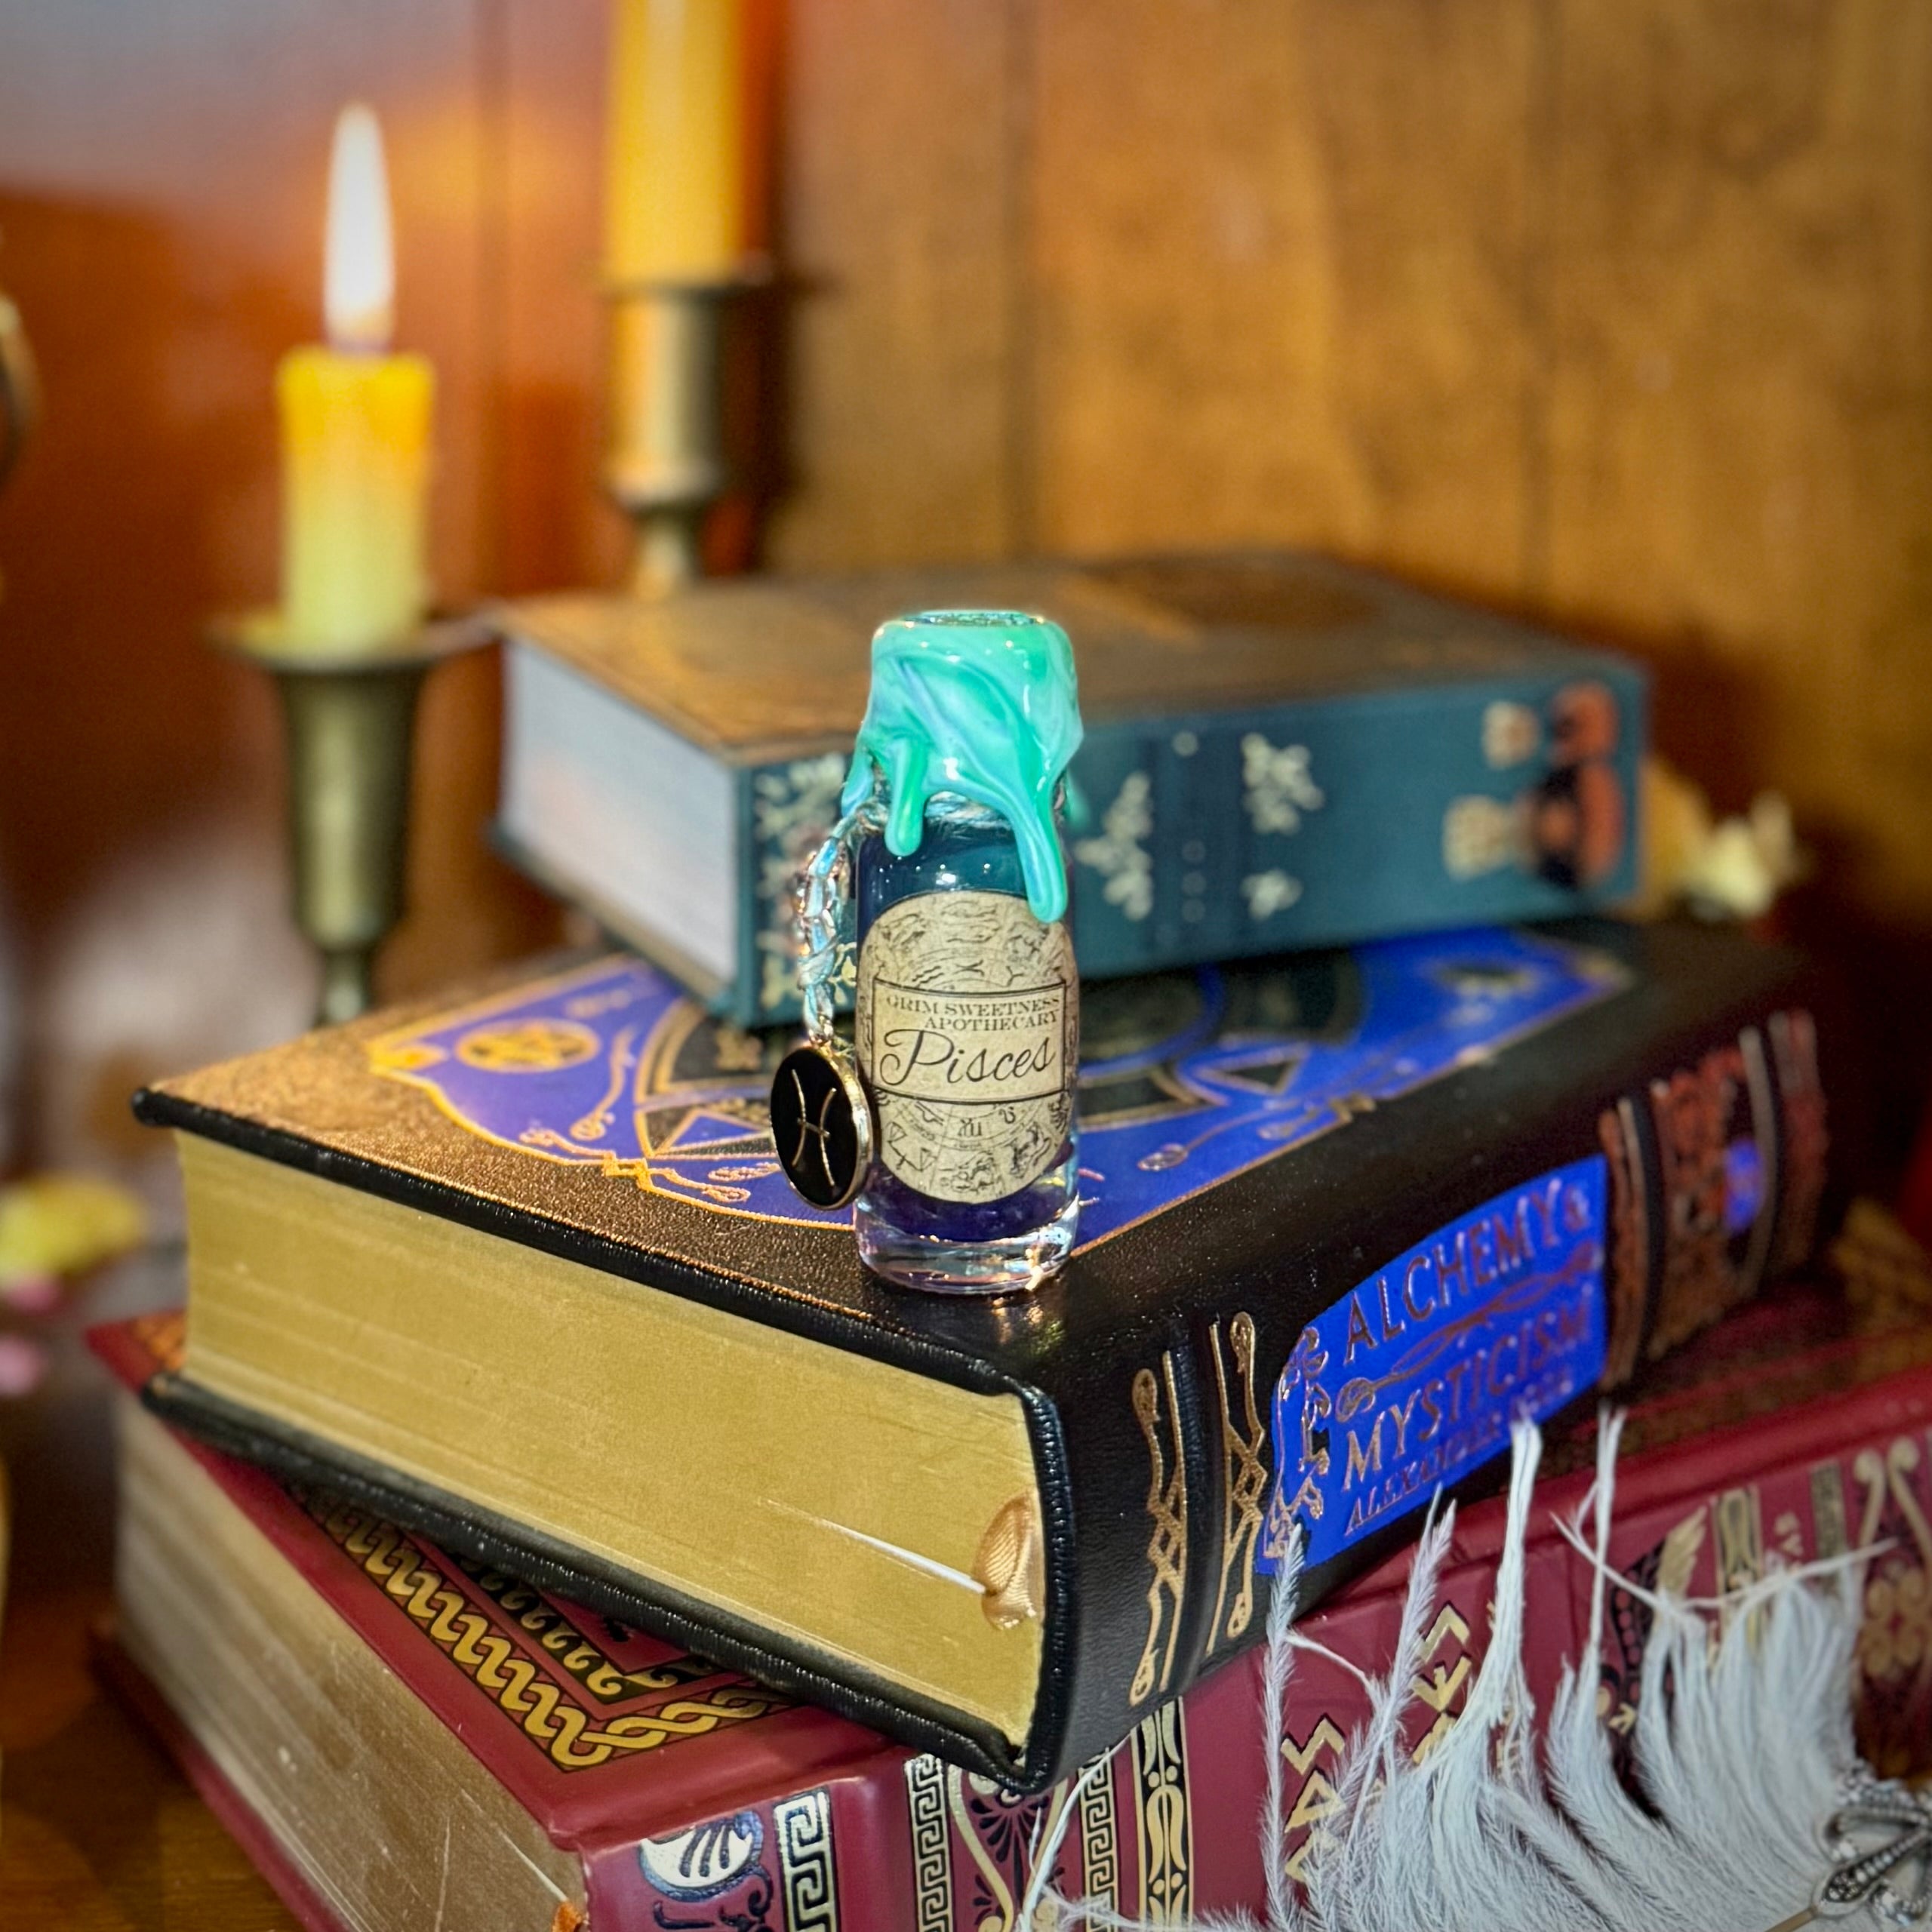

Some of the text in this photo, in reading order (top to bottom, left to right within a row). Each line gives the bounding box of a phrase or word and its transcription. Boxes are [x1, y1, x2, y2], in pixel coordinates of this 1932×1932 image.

[886, 994, 1060, 1017] GRIM SWEETNESS
[924, 1009, 1060, 1032] APOTHECARY
[880, 1029, 1057, 1086] Pisces
[1343, 1177, 1562, 1366] ALCHEMY
[1341, 1283, 1594, 1493] MYSTICISM
